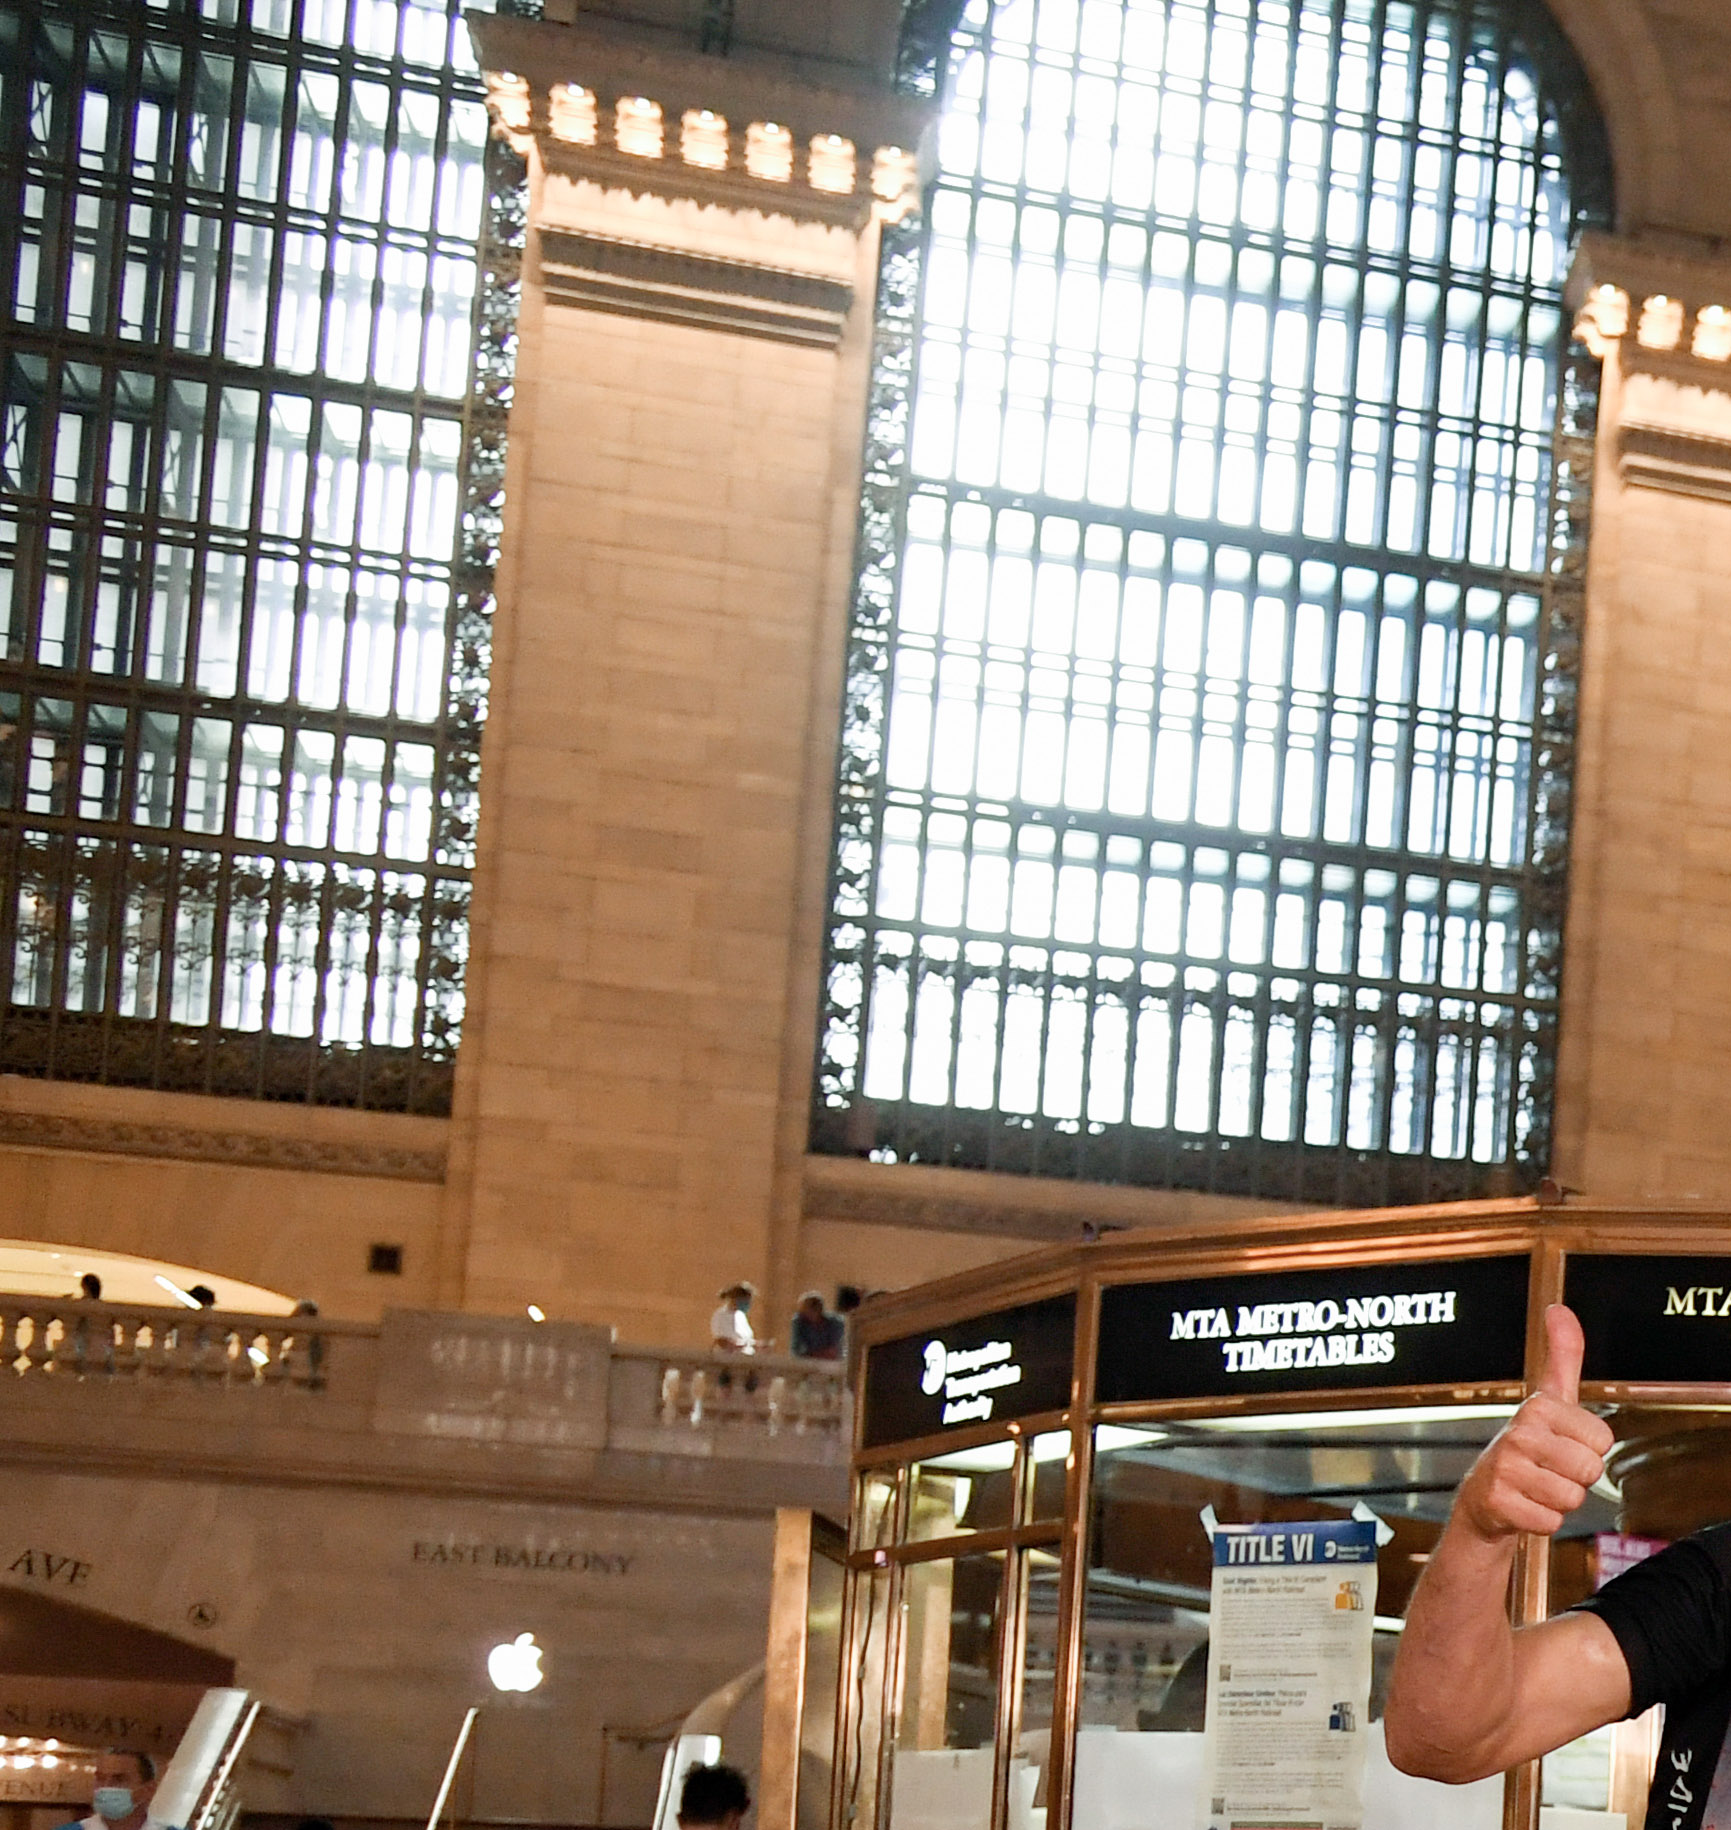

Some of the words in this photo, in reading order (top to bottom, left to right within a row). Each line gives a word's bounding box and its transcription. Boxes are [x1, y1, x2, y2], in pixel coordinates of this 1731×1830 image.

[1169, 1308, 1231, 1341] MTA
[1235, 1291, 1456, 1338] METRO-NORTH
[1222, 1331, 1396, 1374] TIMETABLES
[411, 1540, 484, 1566] EAST
[493, 1544, 636, 1577] BALCONY
[1226, 1534, 1286, 1564] TITLE
[1291, 1533, 1314, 1562] VI
[7, 1549, 92, 1585] AVE
[0, 1778, 65, 1797] ENUE
